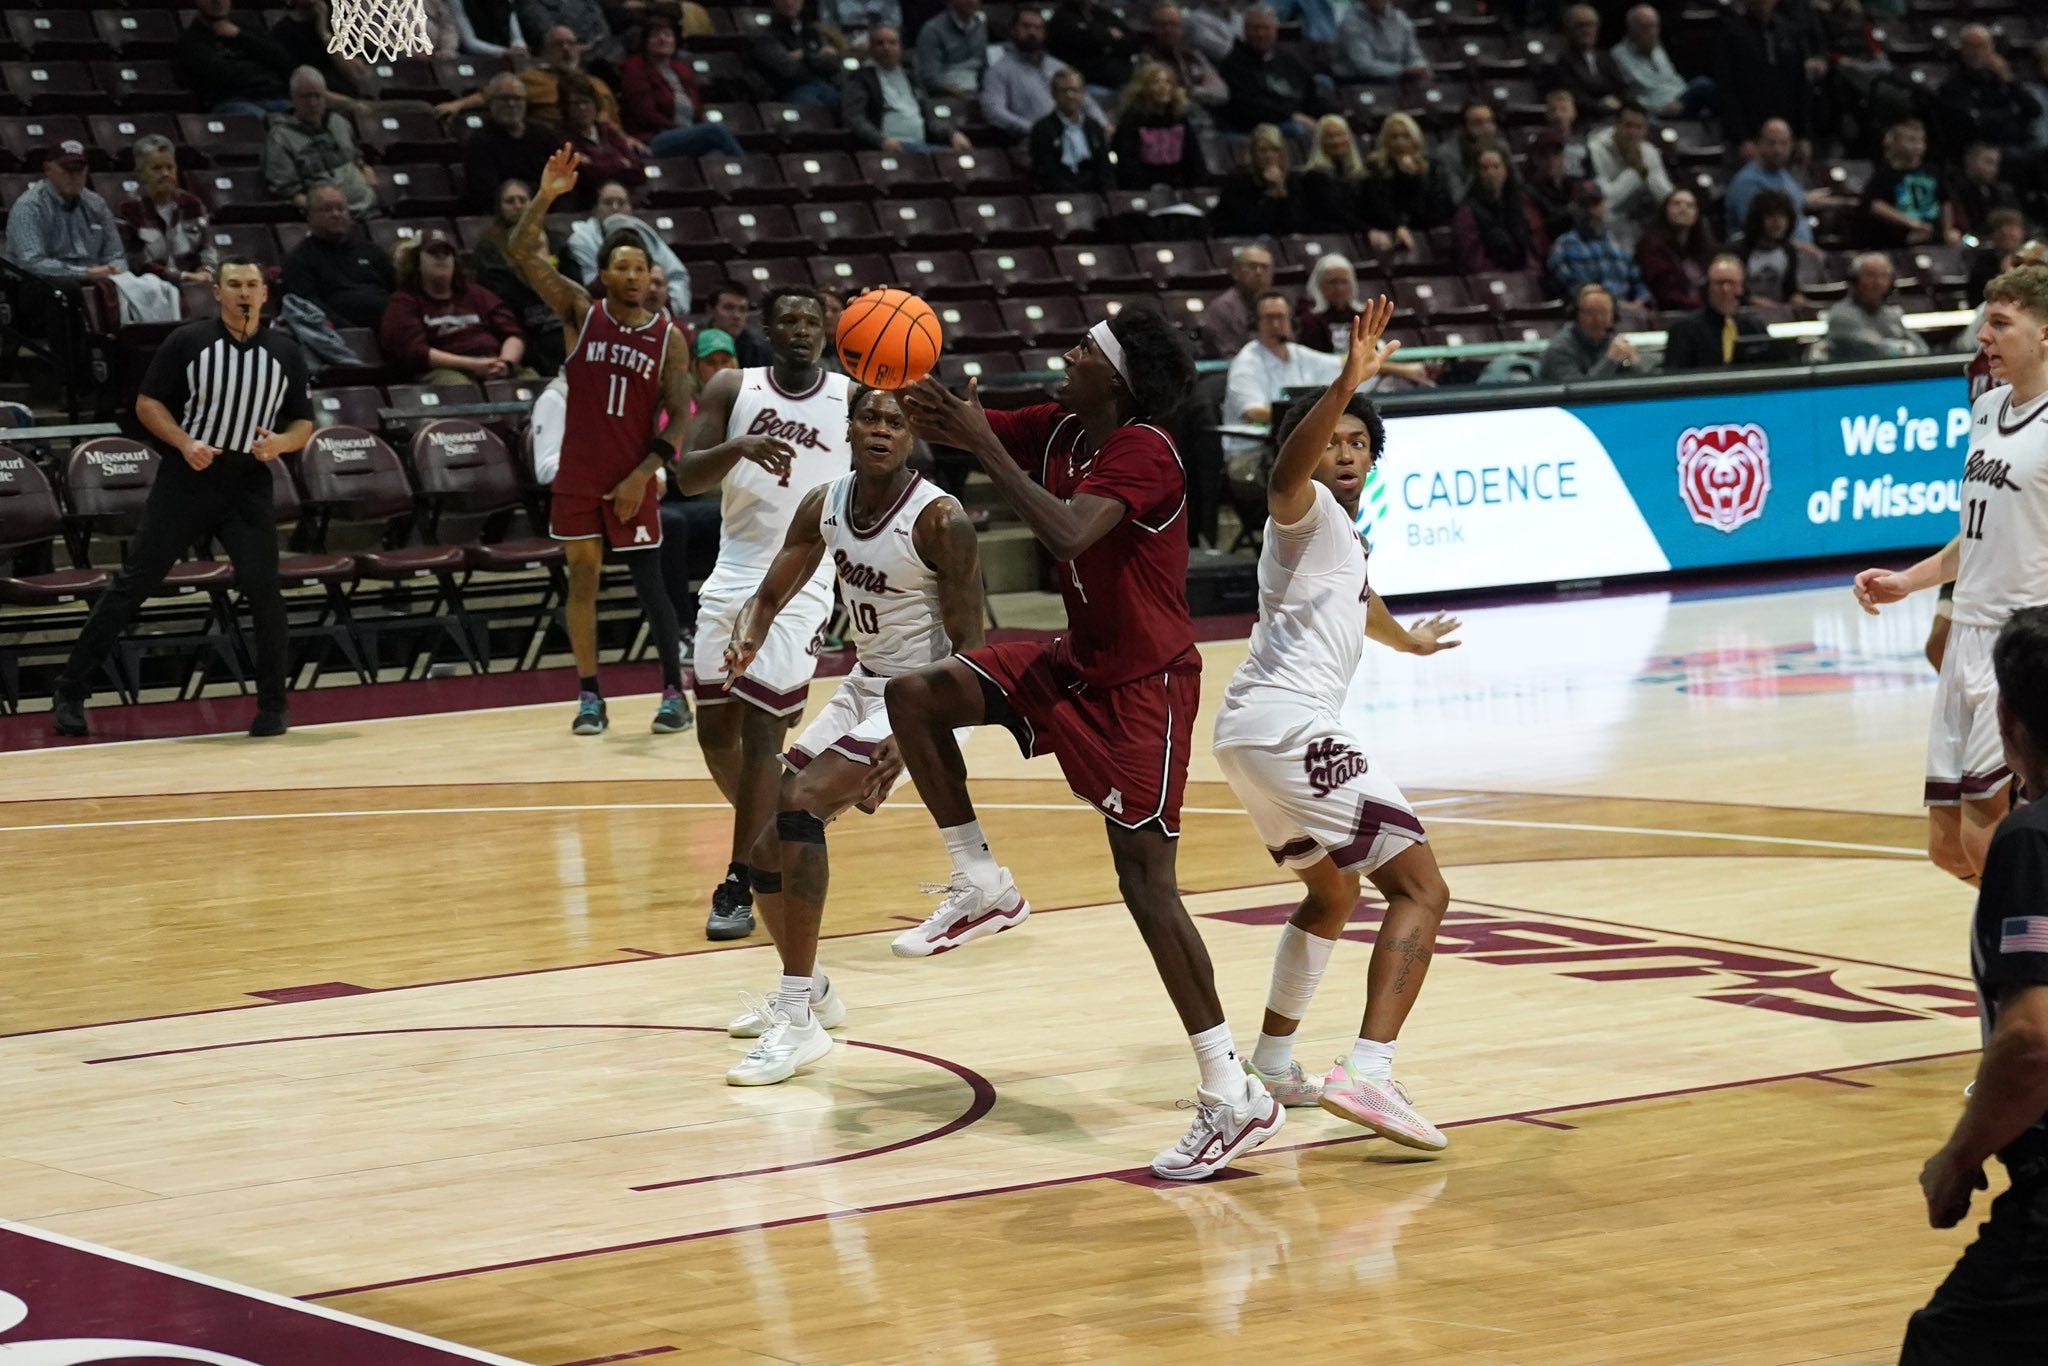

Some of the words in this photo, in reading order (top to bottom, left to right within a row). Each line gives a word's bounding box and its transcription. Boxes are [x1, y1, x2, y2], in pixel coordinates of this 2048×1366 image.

[585, 341, 607, 362] NM
[610, 343, 655, 380] STATE
[606, 374, 628, 417] 11
[316, 435, 376, 451] Missouri
[746, 408, 832, 453] Bears
[1840, 405, 1940, 457] We're
[1946, 407, 1971, 449] P
[85, 448, 150, 465] Missouri
[102, 462, 139, 477] State
[1403, 461, 1578, 511] CADENCE
[1807, 476, 1849, 525] of
[1852, 473, 1963, 521] Missou
[1407, 518, 1464, 547] Bank
[1966, 499, 1987, 539] 11
[834, 548, 907, 594] Bears
[850, 599, 879, 634] 10
[1310, 751, 1368, 798] State
[1101, 787, 1124, 814] A
